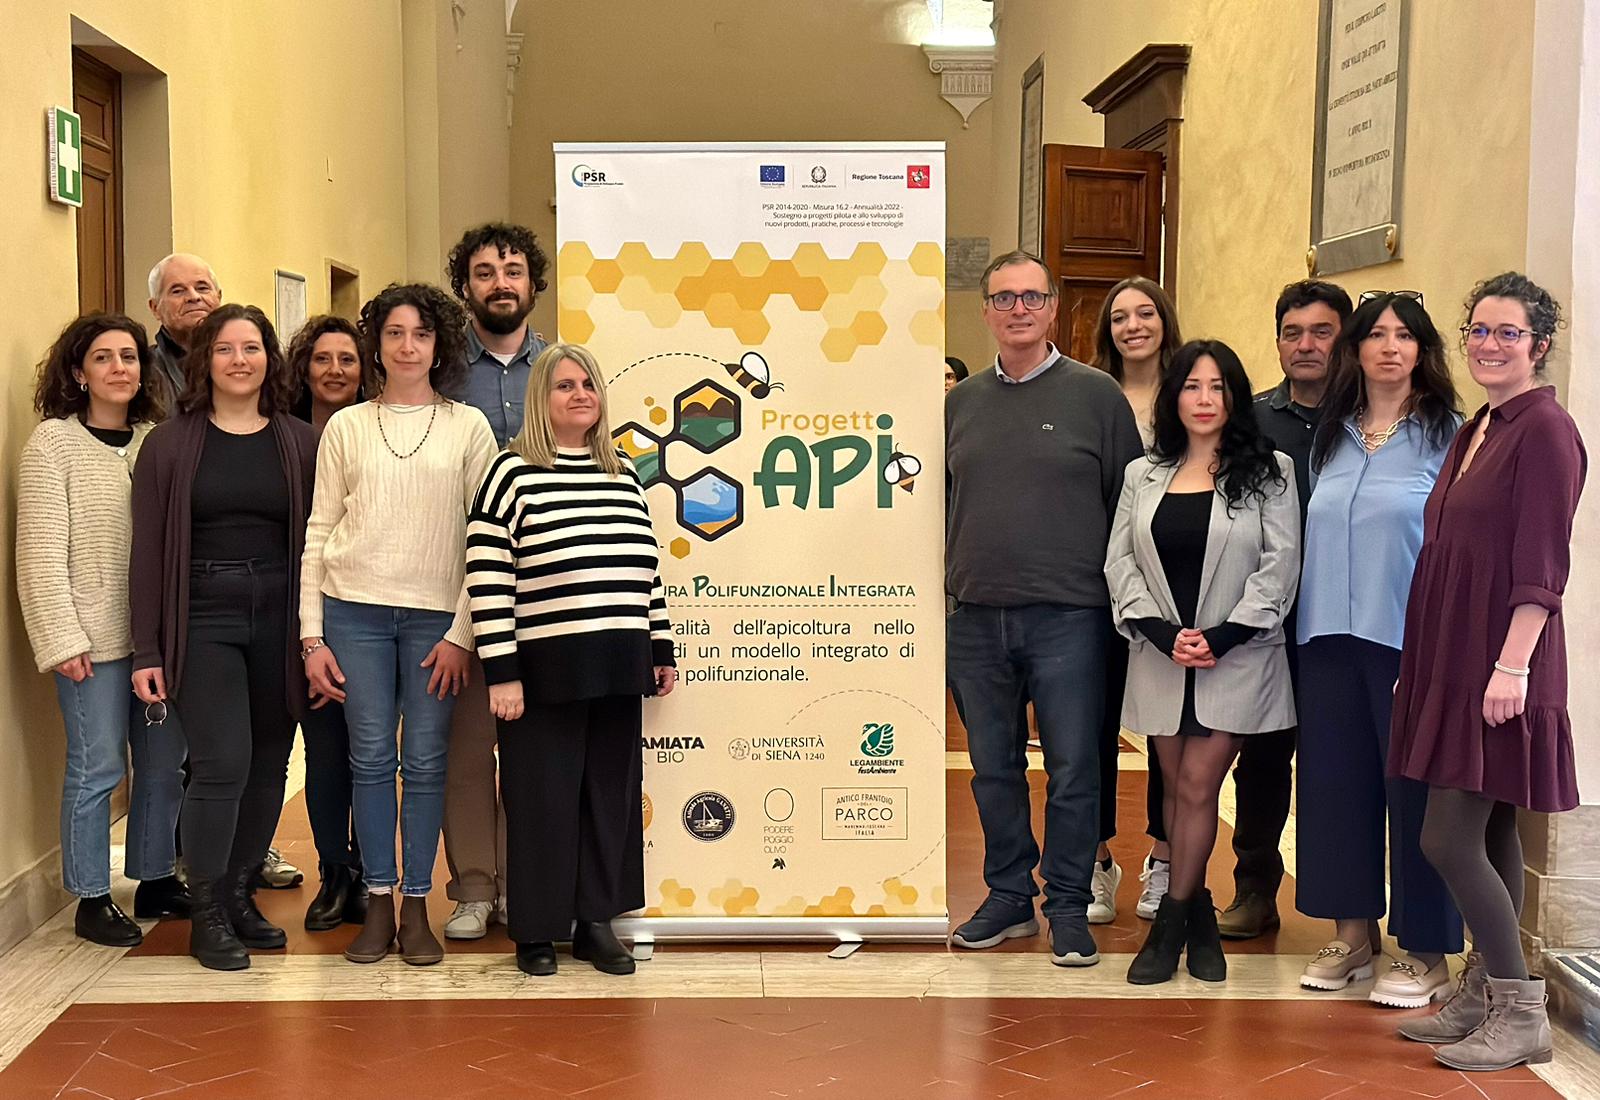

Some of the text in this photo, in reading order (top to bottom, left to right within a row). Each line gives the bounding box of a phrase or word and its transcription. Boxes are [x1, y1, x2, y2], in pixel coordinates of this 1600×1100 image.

[583, 172, 606, 182] PSR
[852, 173, 877, 181] Regione
[854, 203, 883, 211] Annualità
[773, 212, 802, 220] Sostegno
[808, 212, 833, 220] progetti
[834, 211, 852, 219] pilota
[870, 212, 896, 220] sviluppo
[783, 221, 811, 229] prodotti,
[811, 221, 839, 229] pratiche,
[839, 221, 866, 229] processi
[871, 221, 904, 229] tecnologie
[692, 574, 825, 597] POLIFUNZIONALE
[829, 574, 916, 597] INTEGRATA
[874, 619, 915, 635] nello
[698, 646, 720, 658] un
[731, 642, 801, 658] modello
[812, 643, 889, 662] integrato
[899, 642, 915, 658] di
[685, 665, 809, 686] polifunzionale.
[752, 734, 825, 748] UNIVERSITÀ
[657, 751, 685, 763] BIO
[751, 750, 825, 761] DI SIENA 1240
[850, 759, 905, 767] LEGAMBIENTE
[836, 793, 893, 806] ANTICO FRANTOIO
[835, 807, 893, 821] PARCO
[763, 825, 795, 833] PODERE
[763, 835, 794, 844] POGGIO
[763, 845, 787, 853] OLIVO
